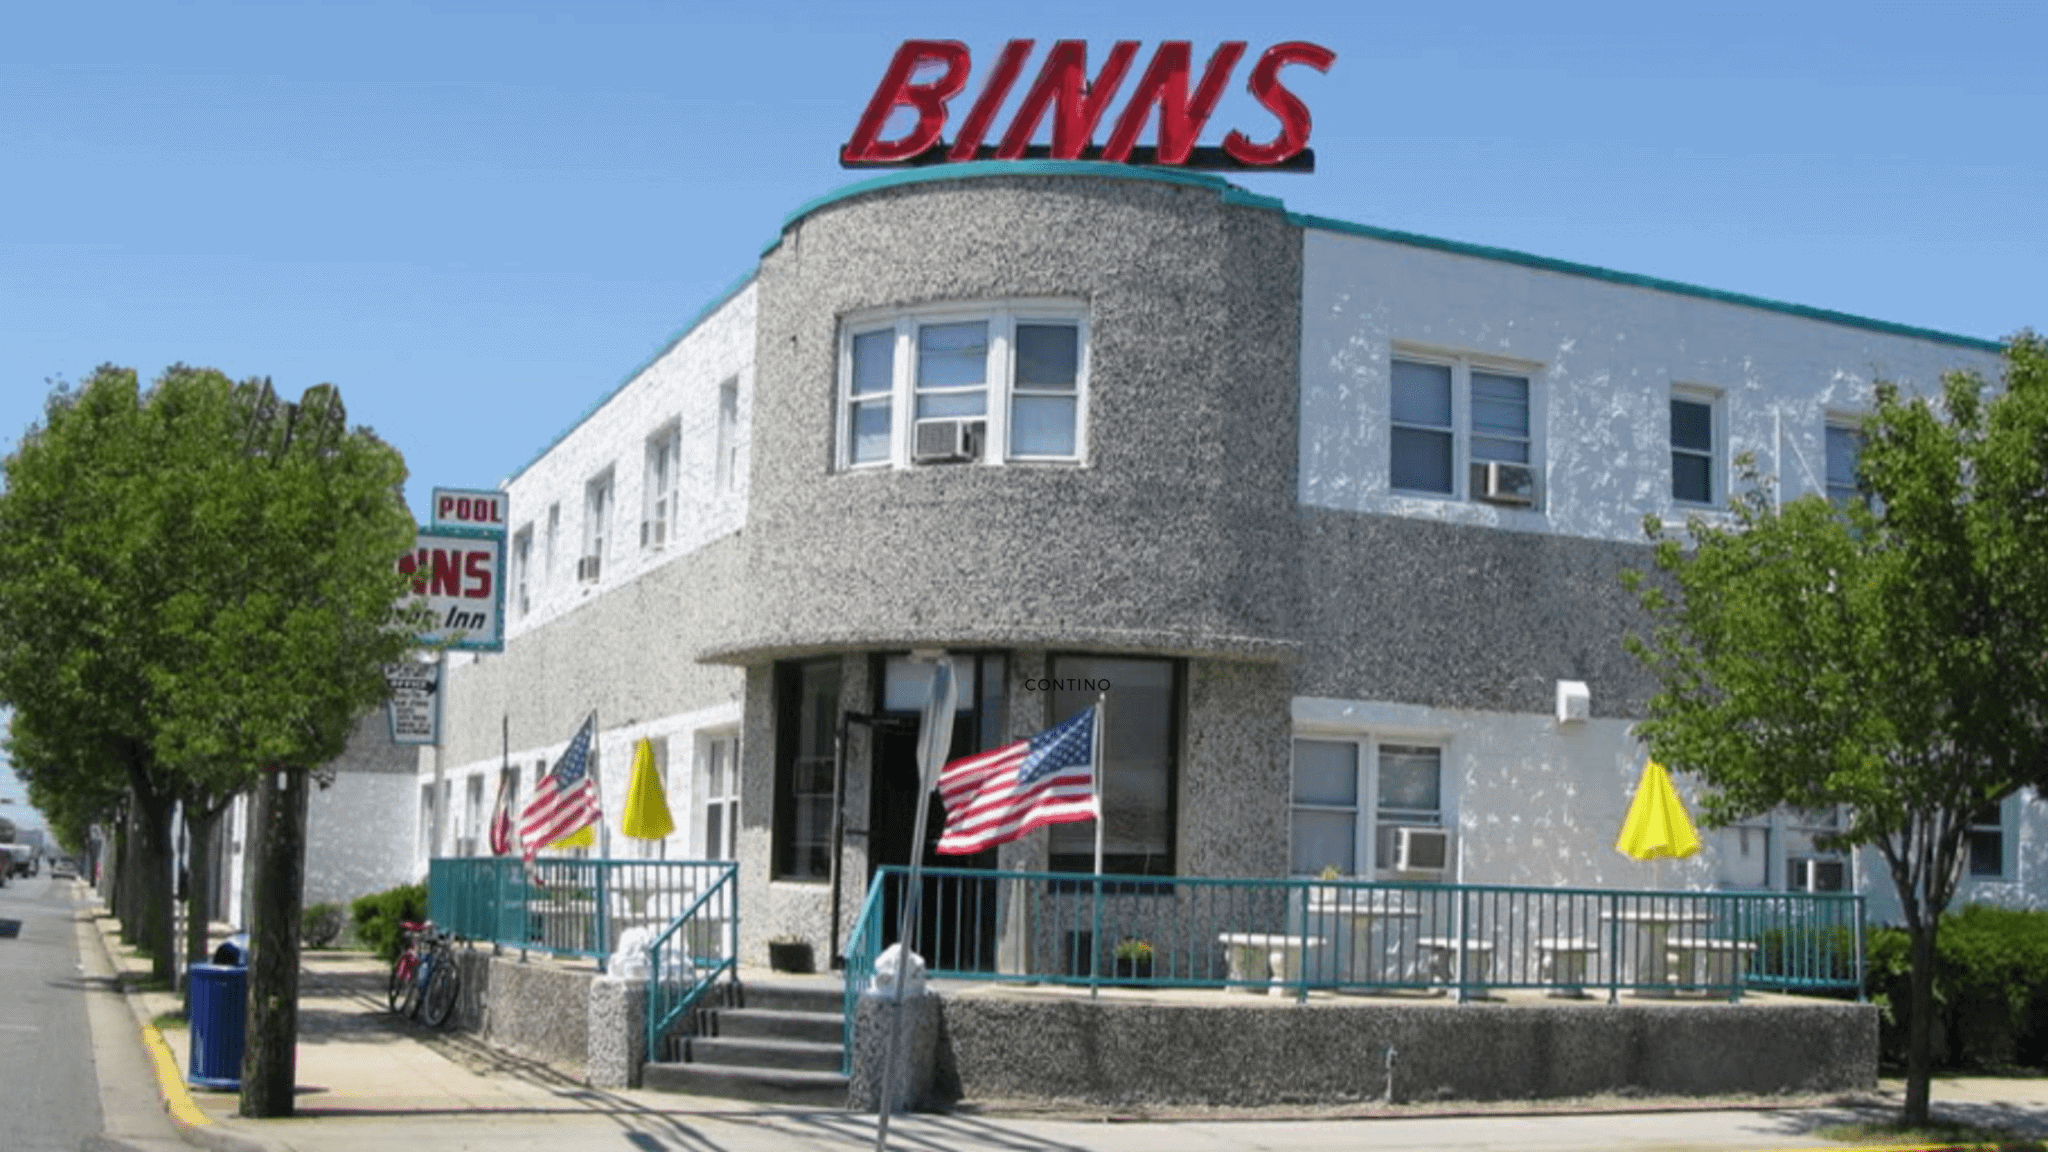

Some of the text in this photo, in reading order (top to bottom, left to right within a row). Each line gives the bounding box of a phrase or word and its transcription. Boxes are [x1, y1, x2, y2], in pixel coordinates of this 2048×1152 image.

[842, 38, 1337, 164] BINNS
[438, 496, 503, 522] POOL
[398, 548, 492, 598] NNS
[445, 605, 486, 629] Inn
